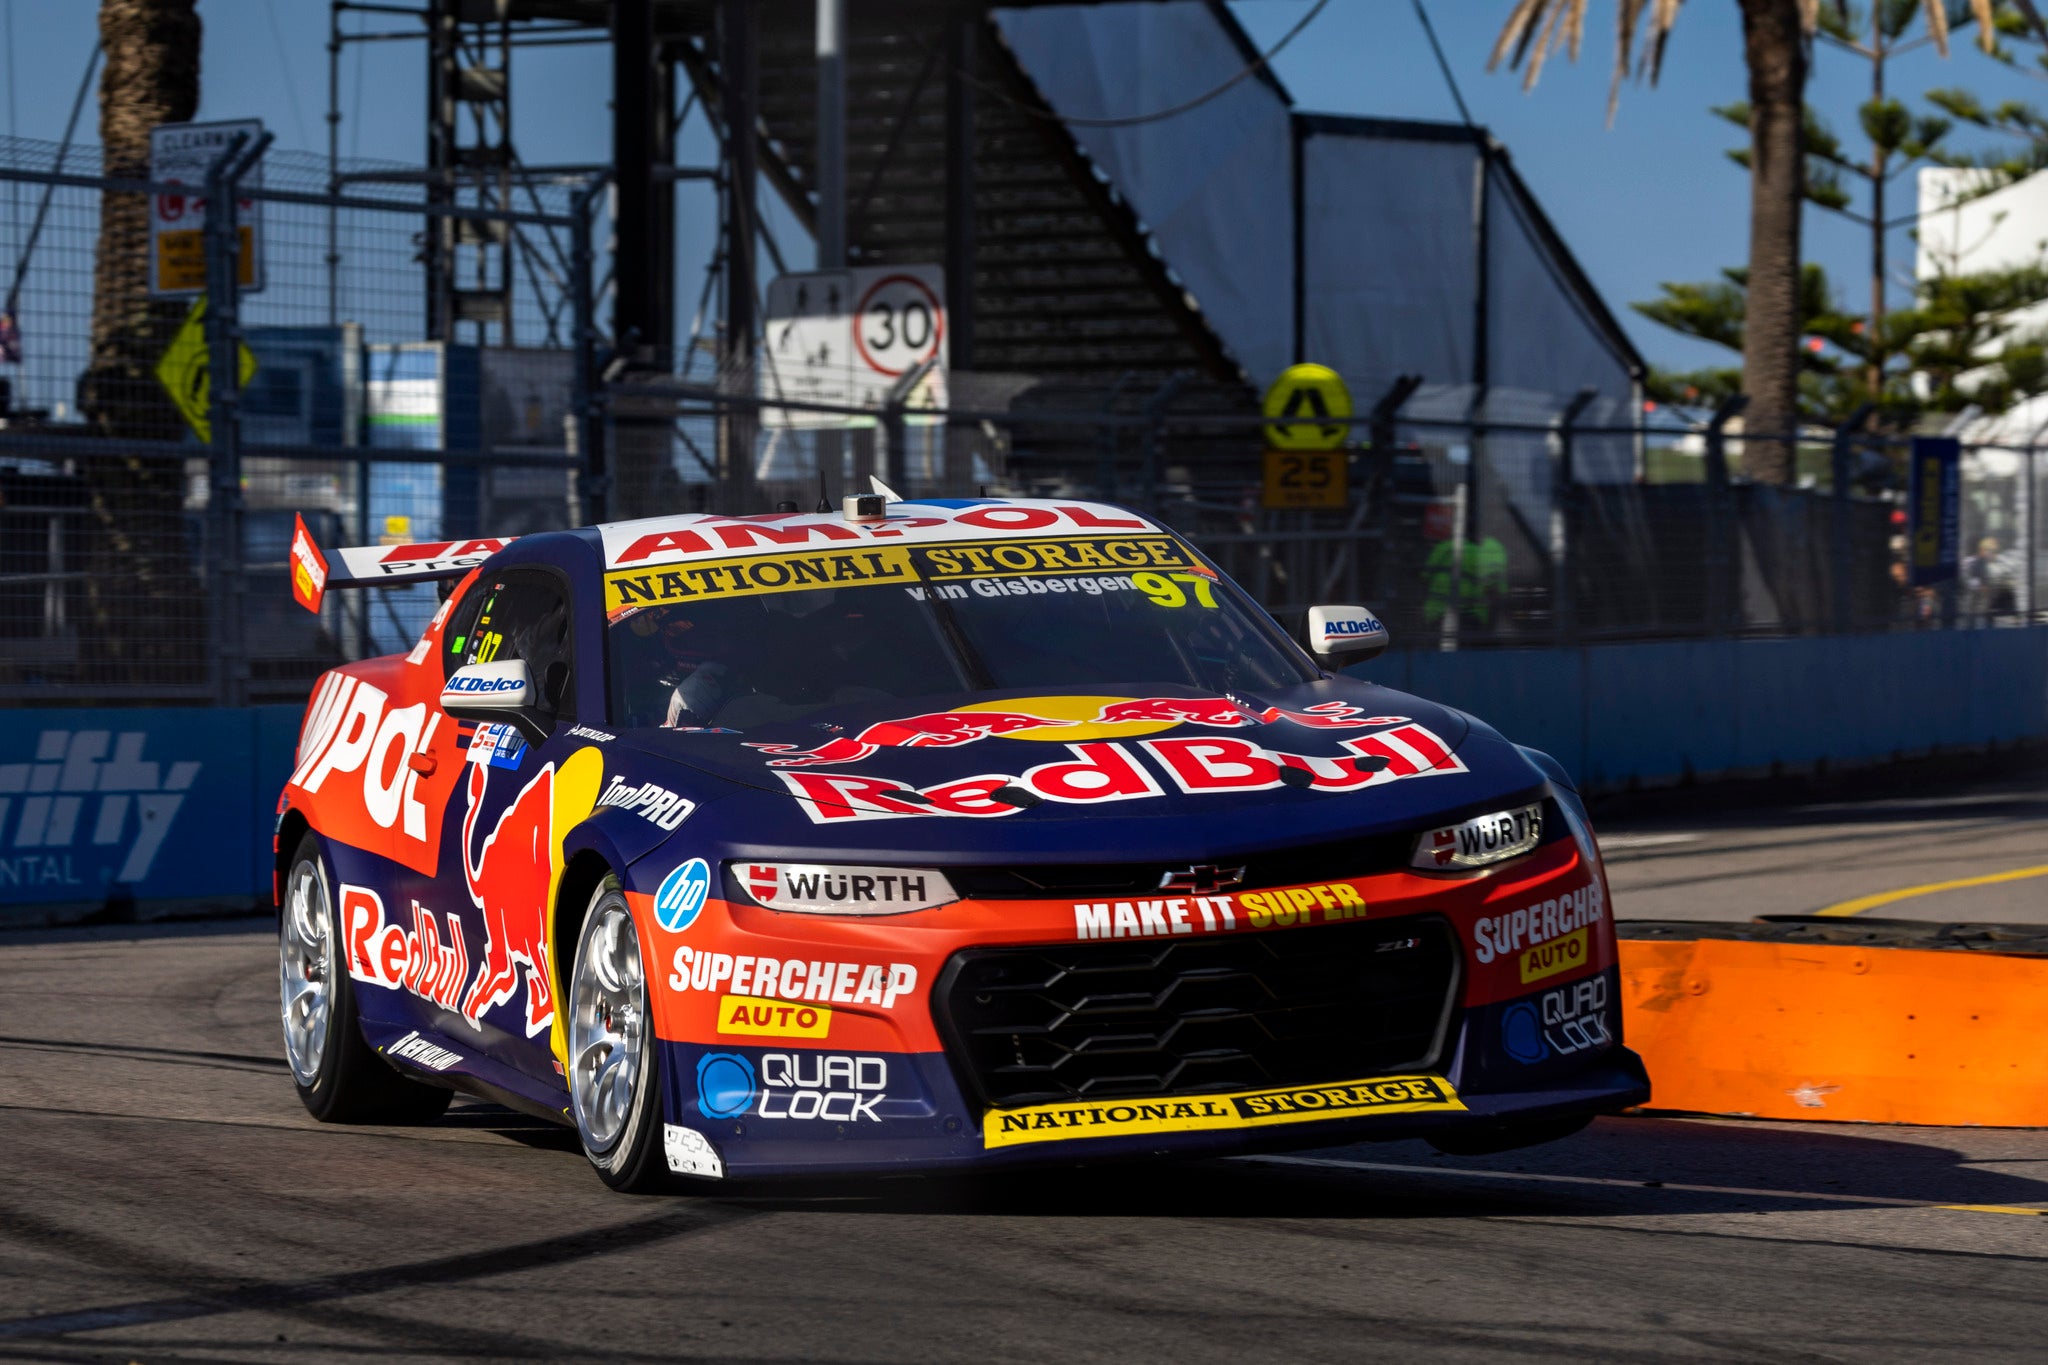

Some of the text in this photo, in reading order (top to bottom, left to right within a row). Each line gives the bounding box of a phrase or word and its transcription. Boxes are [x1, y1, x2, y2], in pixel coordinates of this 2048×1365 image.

[869, 302, 932, 350] 30
[1280, 457, 1331, 487] 25
[614, 506, 1147, 564] AMPOL
[610, 539, 1182, 604] NATIONAL STORAGE
[970, 574, 1138, 598] Gisbergen
[1131, 572, 1219, 608] 97
[445, 677, 526, 692] ACDelco
[771, 725, 1469, 825] Red Bull
[596, 774, 696, 831] ToolPRO
[1460, 808, 1542, 856] WÜRTH
[659, 858, 706, 930] hp
[786, 872, 927, 902] WÜRTH
[1074, 883, 1367, 940] MAKE IT SUPER
[339, 884, 470, 1014] Red Bull
[1527, 938, 1580, 974] AUTO
[669, 945, 918, 1009] SUPERCHEAP
[1542, 975, 1607, 1025] QUAD
[730, 1005, 818, 1029] AUTO
[1543, 1010, 1613, 1055] LOCK
[762, 1053, 887, 1090] QUAD
[758, 1089, 886, 1123] LOCK
[1000, 1078, 1439, 1133] NATIONAL STORAGE
